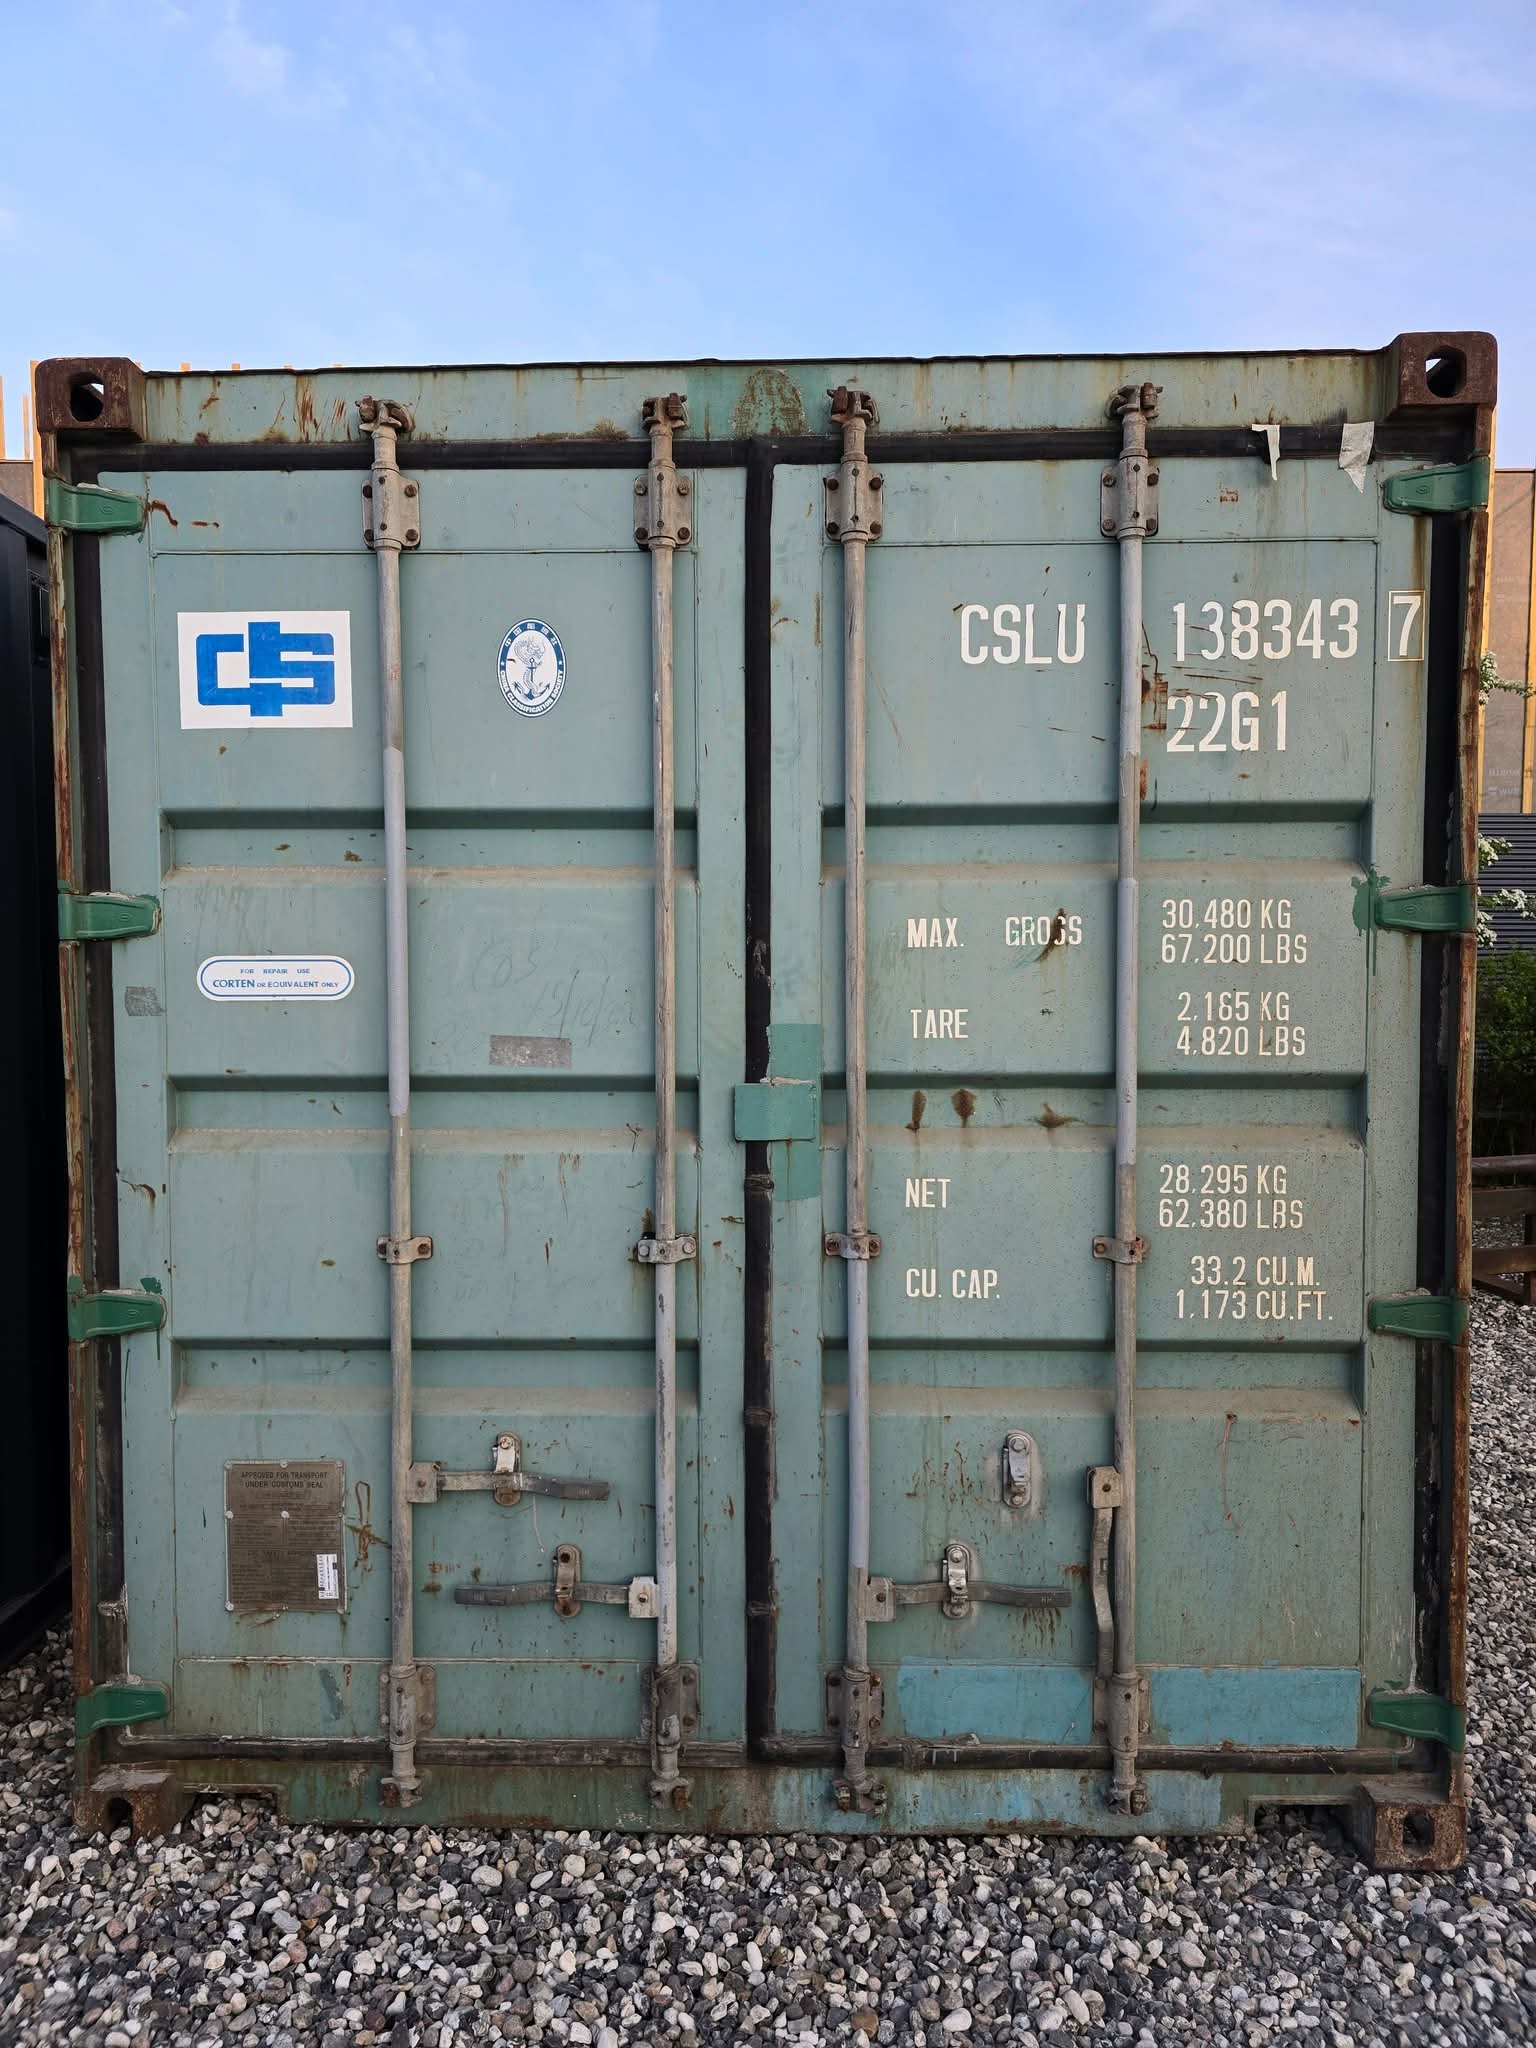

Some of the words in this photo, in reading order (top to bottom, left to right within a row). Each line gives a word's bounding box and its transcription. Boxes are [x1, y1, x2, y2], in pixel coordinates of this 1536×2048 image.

[960, 603, 1086, 665] CSLU
[1173, 598, 1359, 662] 138343
[1393, 595, 1421, 656] 7
[1166, 690, 1287, 753] 22G1
[1162, 898, 1251, 929] 30,480
[1261, 898, 1291, 929] KG
[907, 917, 965, 948] MAX.
[1161, 933, 1251, 964] 67,200
[1260, 933, 1307, 964] LBS
[212, 979, 255, 988] CORTEN
[1260, 991, 1290, 1021] KG
[910, 1008, 969, 1039] TARE
[1176, 1025, 1249, 1056] 4,820
[1258, 1026, 1306, 1056] LBS
[905, 1178, 951, 1209] NET
[1159, 1164, 1248, 1195] 28,295
[1257, 1164, 1287, 1195] KG
[1159, 1198, 1247, 1229] 62,380
[1256, 1199, 1303, 1229] LBS
[906, 1268, 942, 1298] CU.
[952, 1269, 1000, 1299] CAP.
[1191, 1255, 1247, 1286] 33.2
[1176, 1288, 1246, 1320] 1,173
[245, 1481, 268, 1489] UNDER
